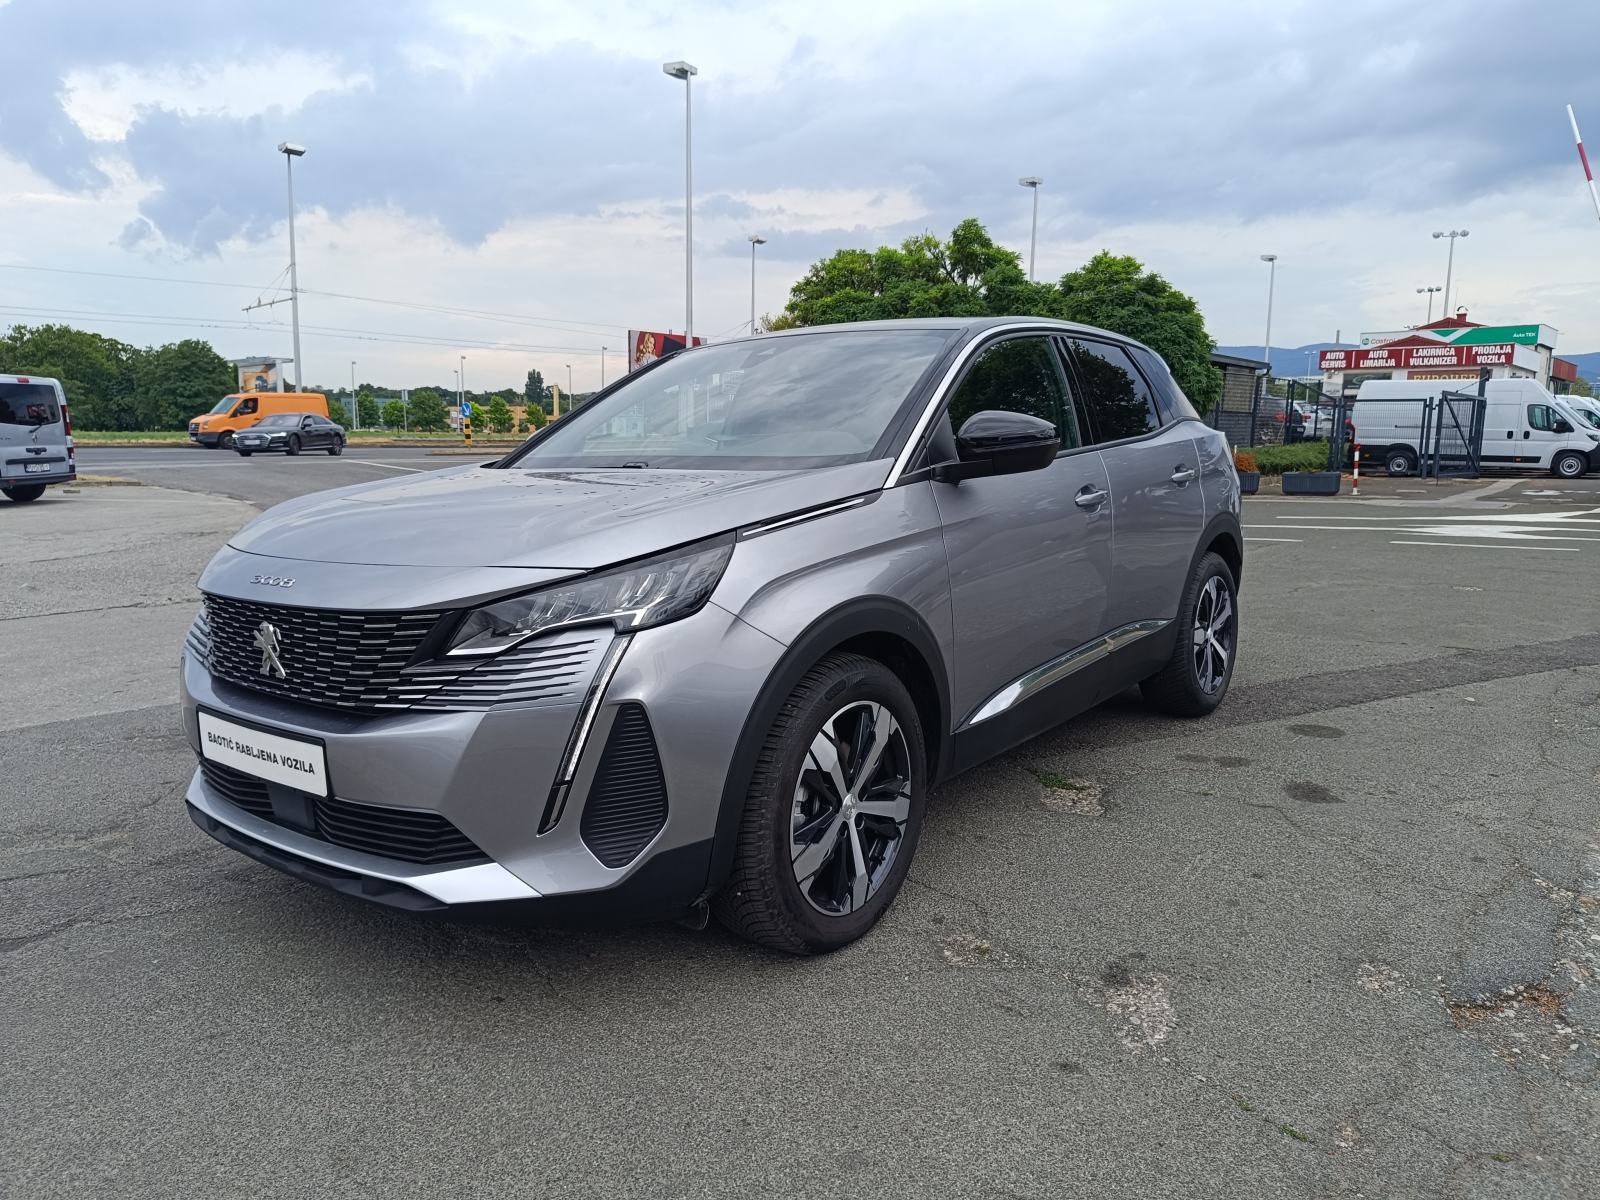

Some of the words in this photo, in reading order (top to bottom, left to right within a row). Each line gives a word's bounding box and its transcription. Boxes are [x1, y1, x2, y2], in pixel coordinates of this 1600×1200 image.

[1413, 347, 1456, 357] LAKIRNICA
[1472, 345, 1511, 355] PRODAJA
[1325, 351, 1345, 360] AUTO
[1368, 351, 1388, 359] AUTO
[1476, 355, 1505, 364] VOZILA
[1321, 360, 1346, 369] SERVIS
[1360, 359, 1395, 368] LIMARIJA
[1409, 357, 1457, 366] VULKANIZER
[249, 575, 296, 588] 3008
[207, 732, 234, 750] BAOTIĆ
[235, 741, 279, 765] RABLJENA
[280, 754, 315, 775] VOZILA
